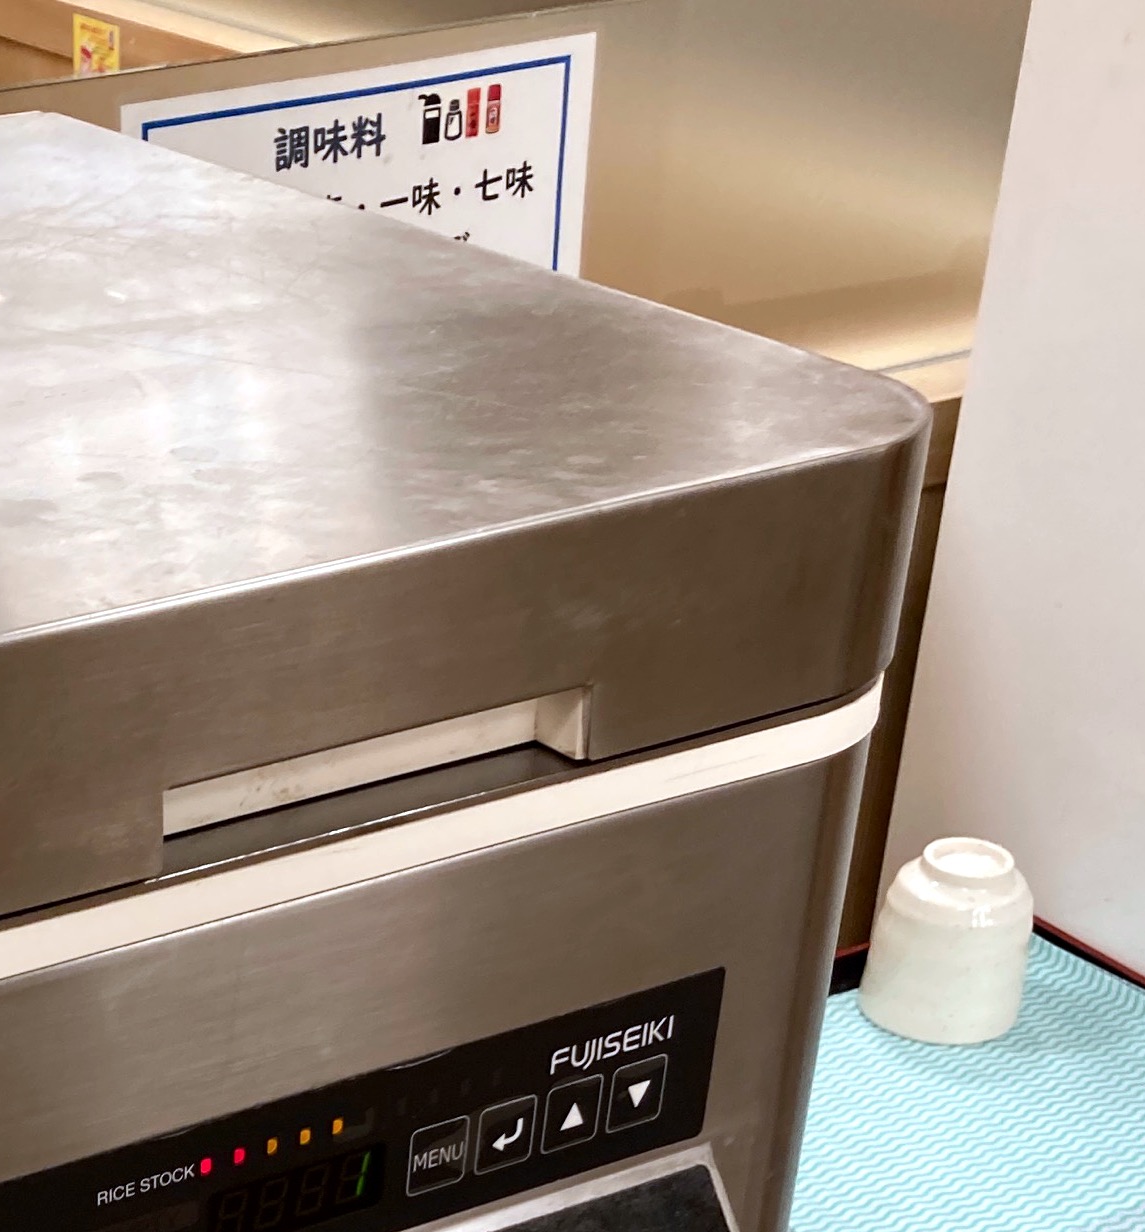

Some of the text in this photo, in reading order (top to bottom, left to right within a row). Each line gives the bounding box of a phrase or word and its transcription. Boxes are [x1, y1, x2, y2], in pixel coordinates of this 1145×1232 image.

[273, 113, 385, 171] 調味料
[326, 161, 533, 215] ・一味・七味
[549, 1014, 674, 1075] FUJISEIKI
[412, 1141, 464, 1172] MENU
[97, 1164, 196, 1206] RICE STOCK
